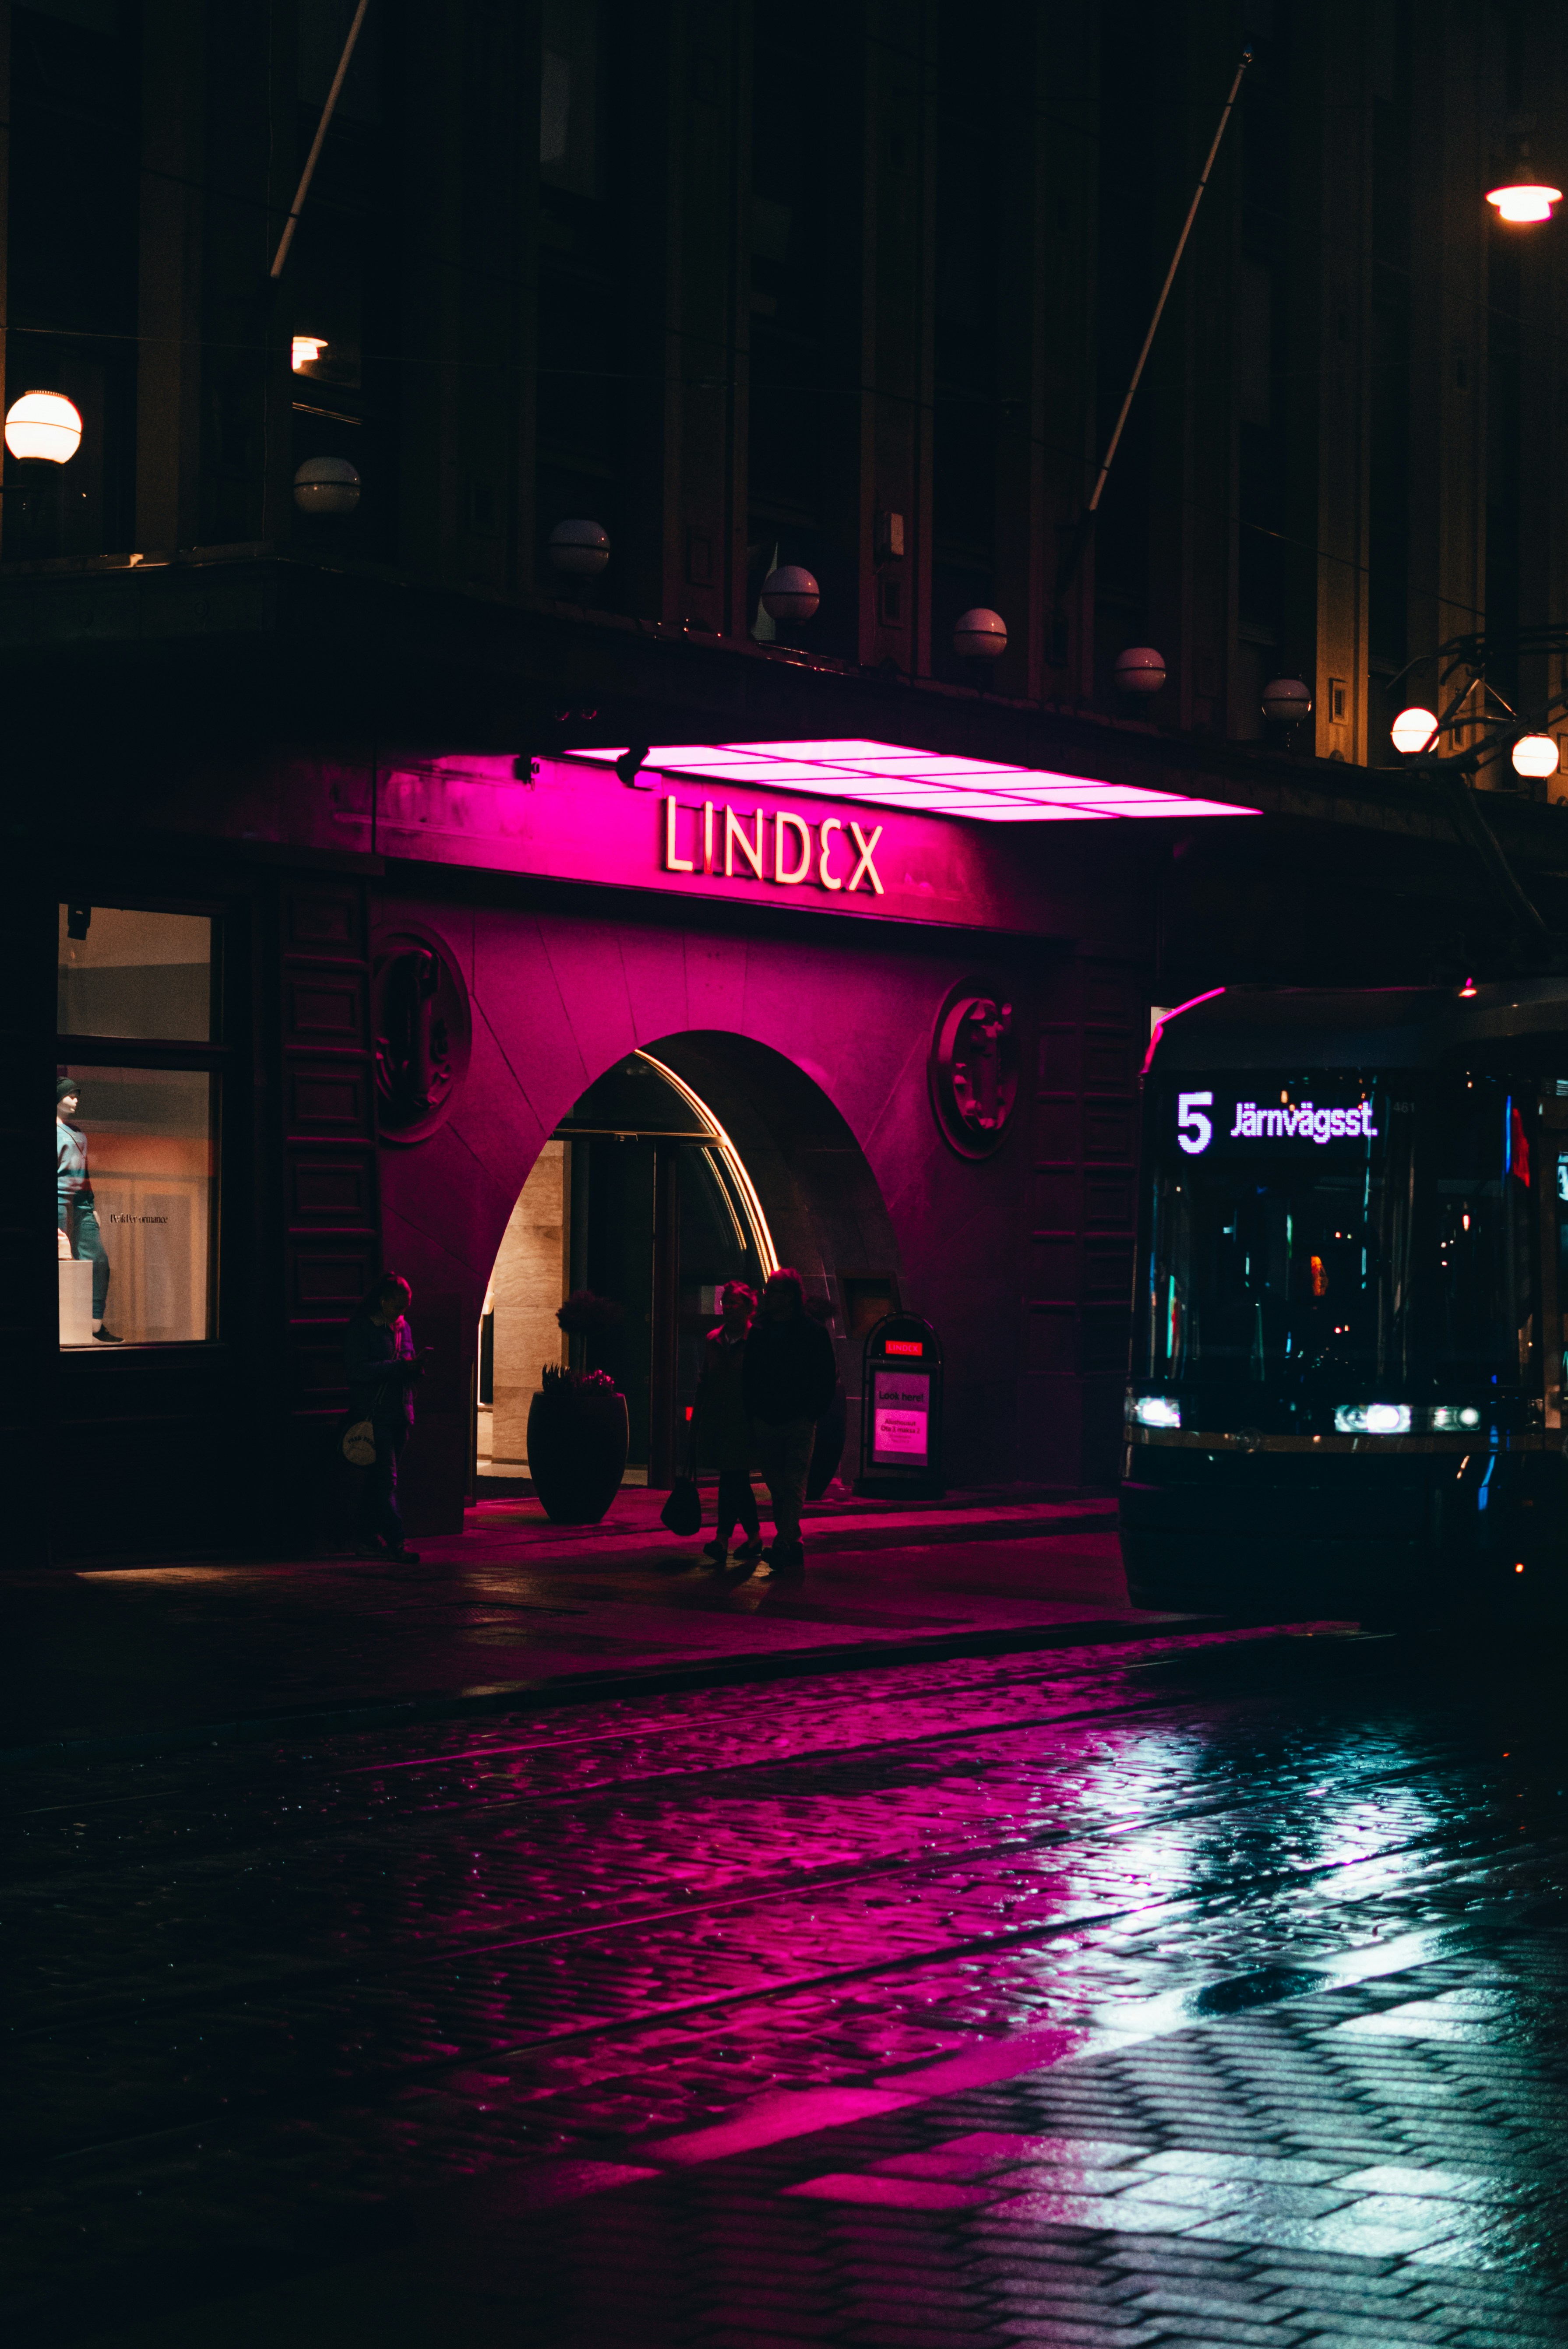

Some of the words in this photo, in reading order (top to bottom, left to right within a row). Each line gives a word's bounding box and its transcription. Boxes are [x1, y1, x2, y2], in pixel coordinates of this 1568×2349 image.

[667, 795, 884, 895] LINDEX
[1178, 1092, 1212, 1154] 5
[1231, 1102, 1378, 1143] Järnvägsst.
[1393, 1102, 1414, 1113] 461
[879, 1391, 899, 1400] Look
[902, 1393, 923, 1402] here!
